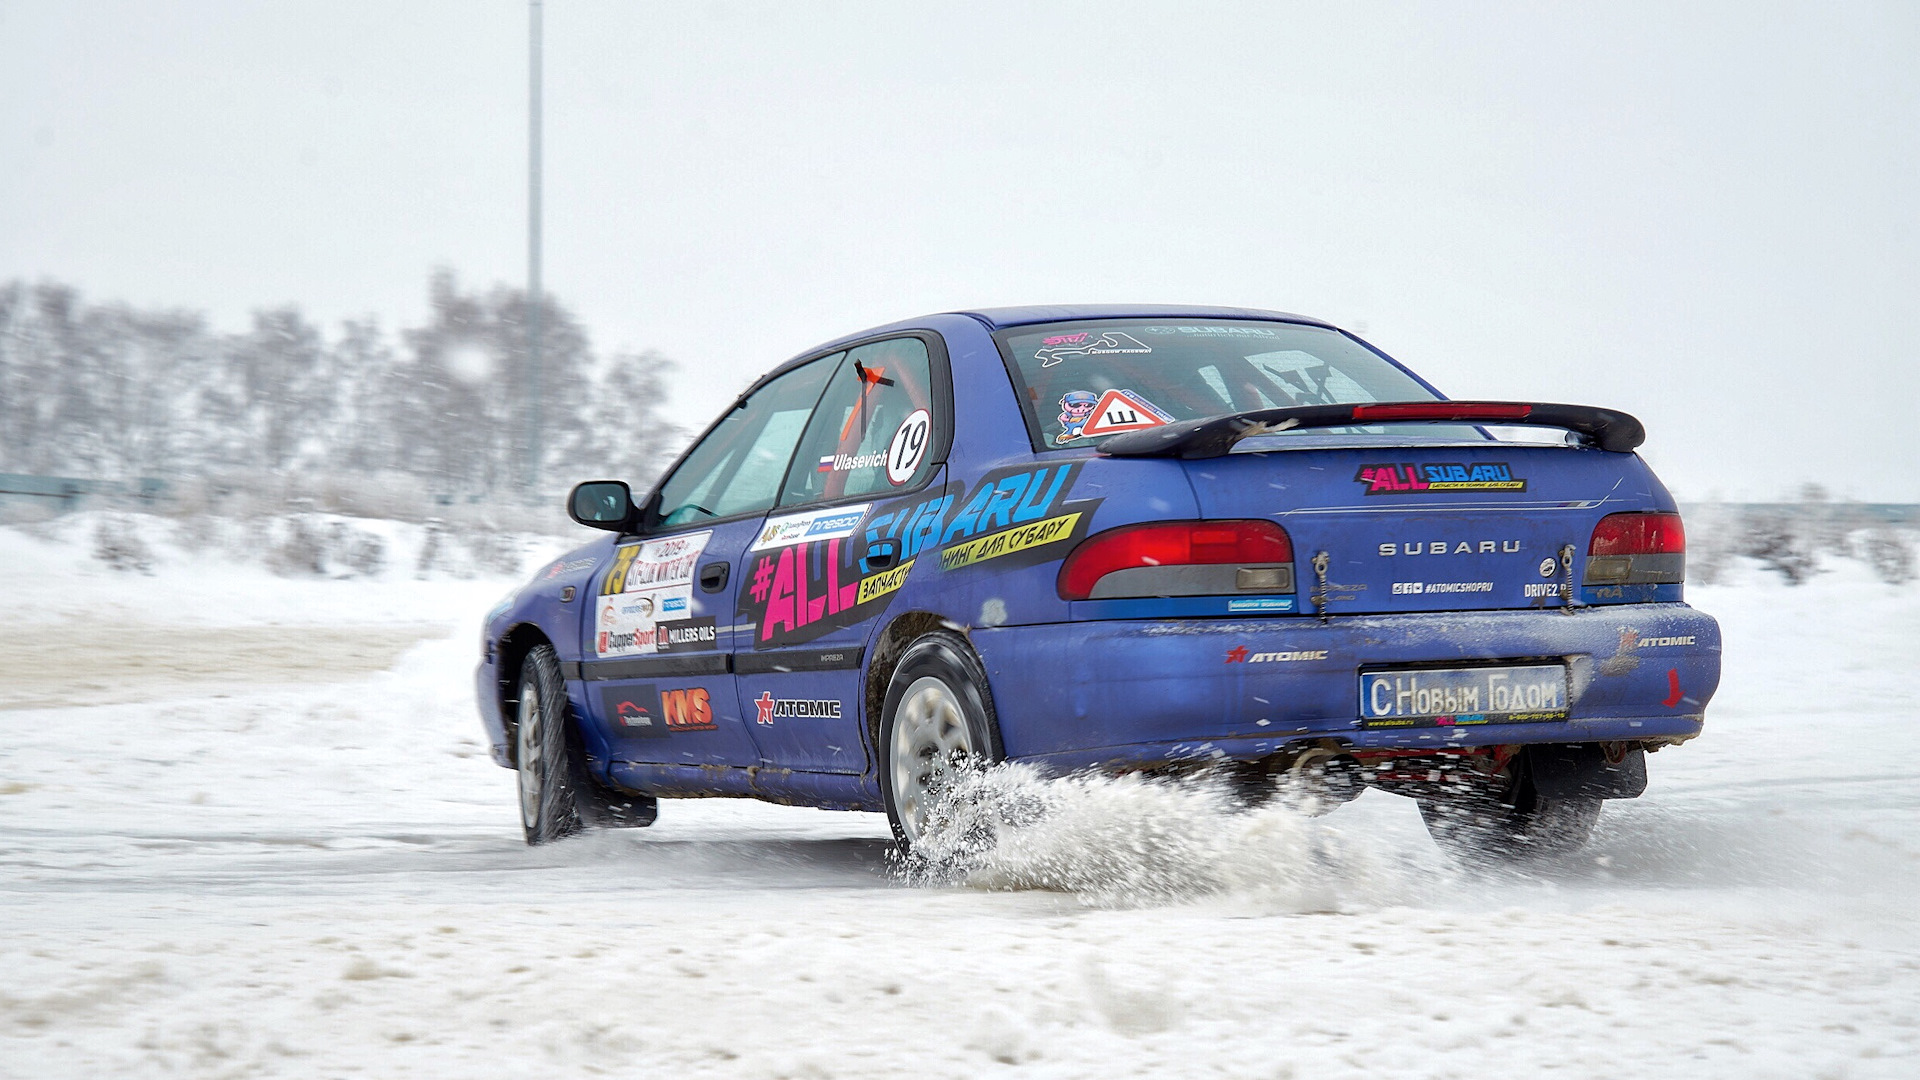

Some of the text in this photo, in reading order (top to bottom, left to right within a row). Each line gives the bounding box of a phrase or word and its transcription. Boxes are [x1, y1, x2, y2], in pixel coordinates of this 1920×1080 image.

[1178, 326, 1276, 336] SUBARU
[894, 420, 927, 470] 19
[833, 449, 888, 471] Ulasevich
[1425, 465, 1512, 482] SUBARU
[976, 537, 1006, 559] ДЛЯ
[1008, 518, 1070, 549] СУБАРУ
[1379, 540, 1520, 556] SUBARU
[750, 463, 1073, 642] #ALL SUBARU
[669, 625, 715, 644] MILLERS OILS
[1638, 636, 1696, 647] ATOMIC
[1248, 650, 1329, 663] ATOMIC
[1371, 678, 1392, 716] С
[774, 699, 842, 719] ATOMIC
